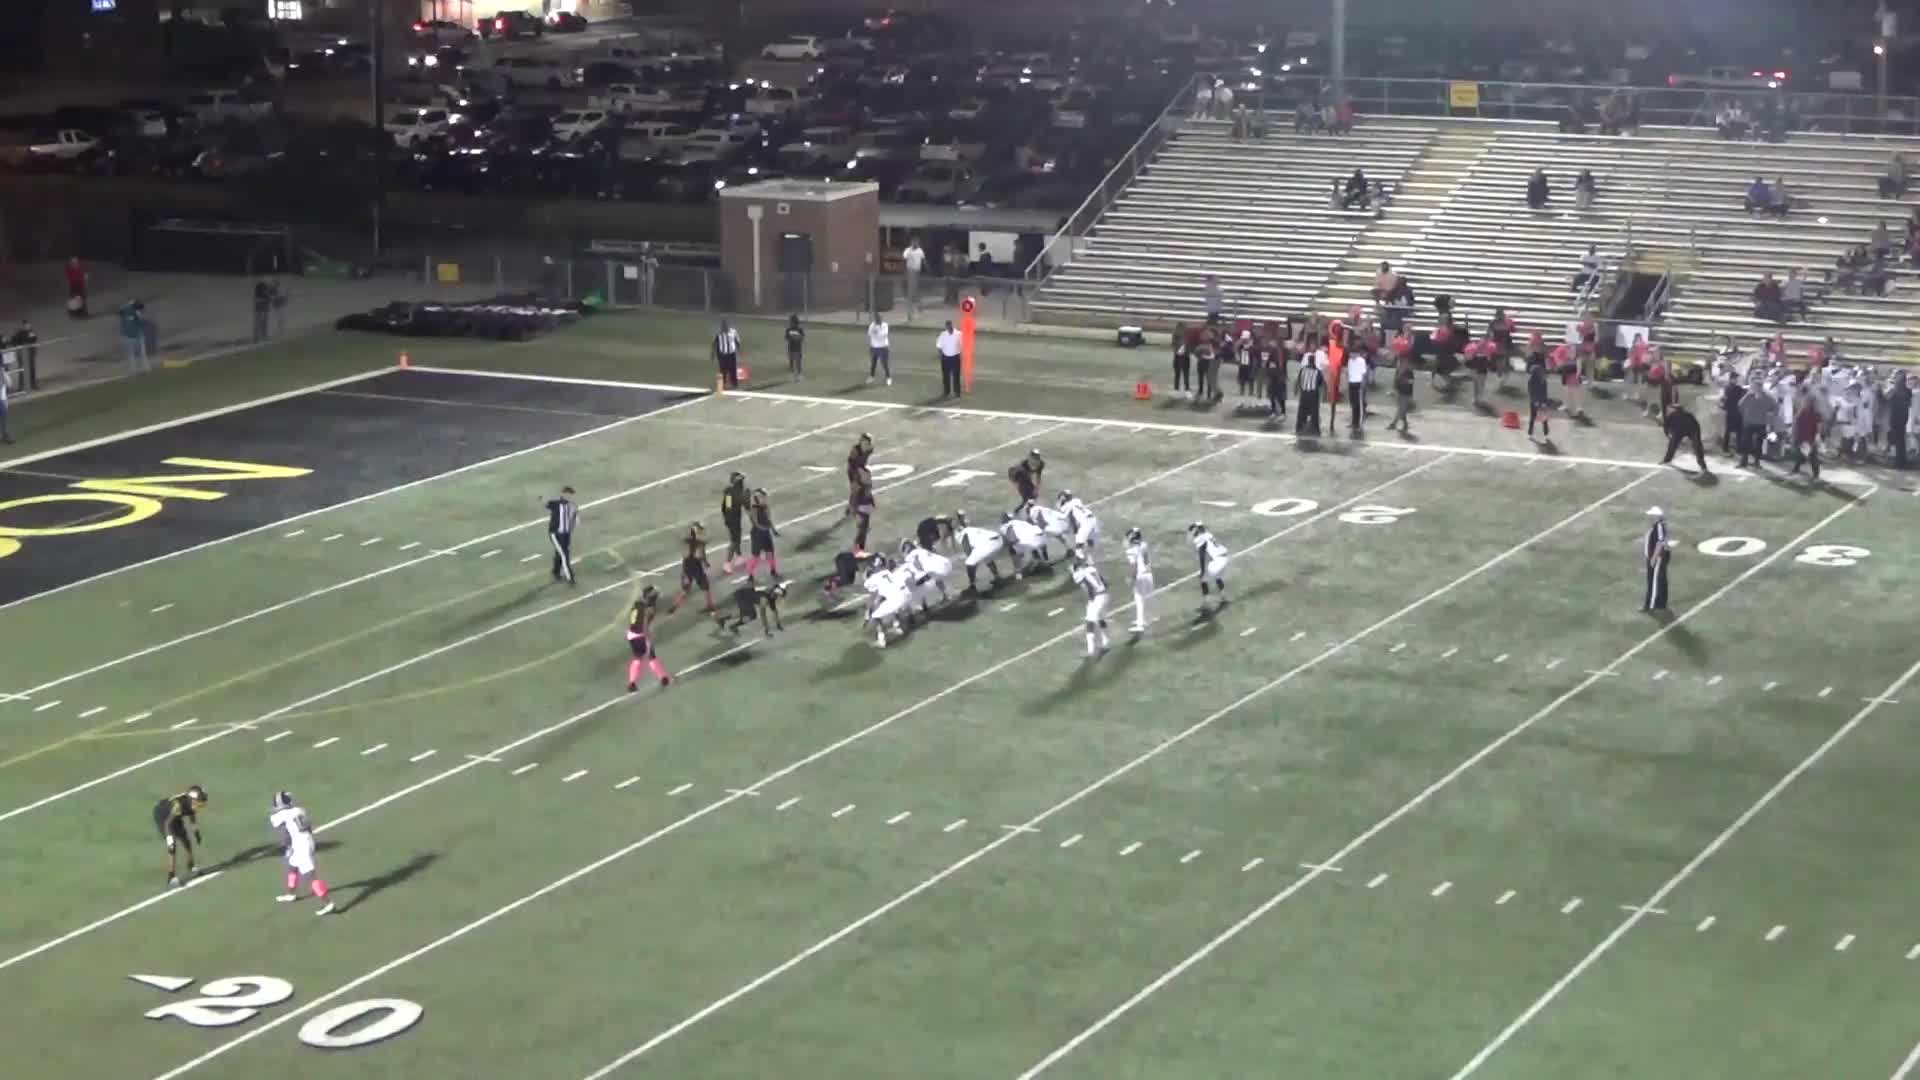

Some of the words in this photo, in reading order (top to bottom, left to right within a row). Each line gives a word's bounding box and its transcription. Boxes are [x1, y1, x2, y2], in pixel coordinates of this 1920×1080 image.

[0, 457, 314, 558] ON
[1250, 498, 1417, 525] 20
[1696, 536, 1872, 567] 30
[145, 975, 424, 1048] 20
